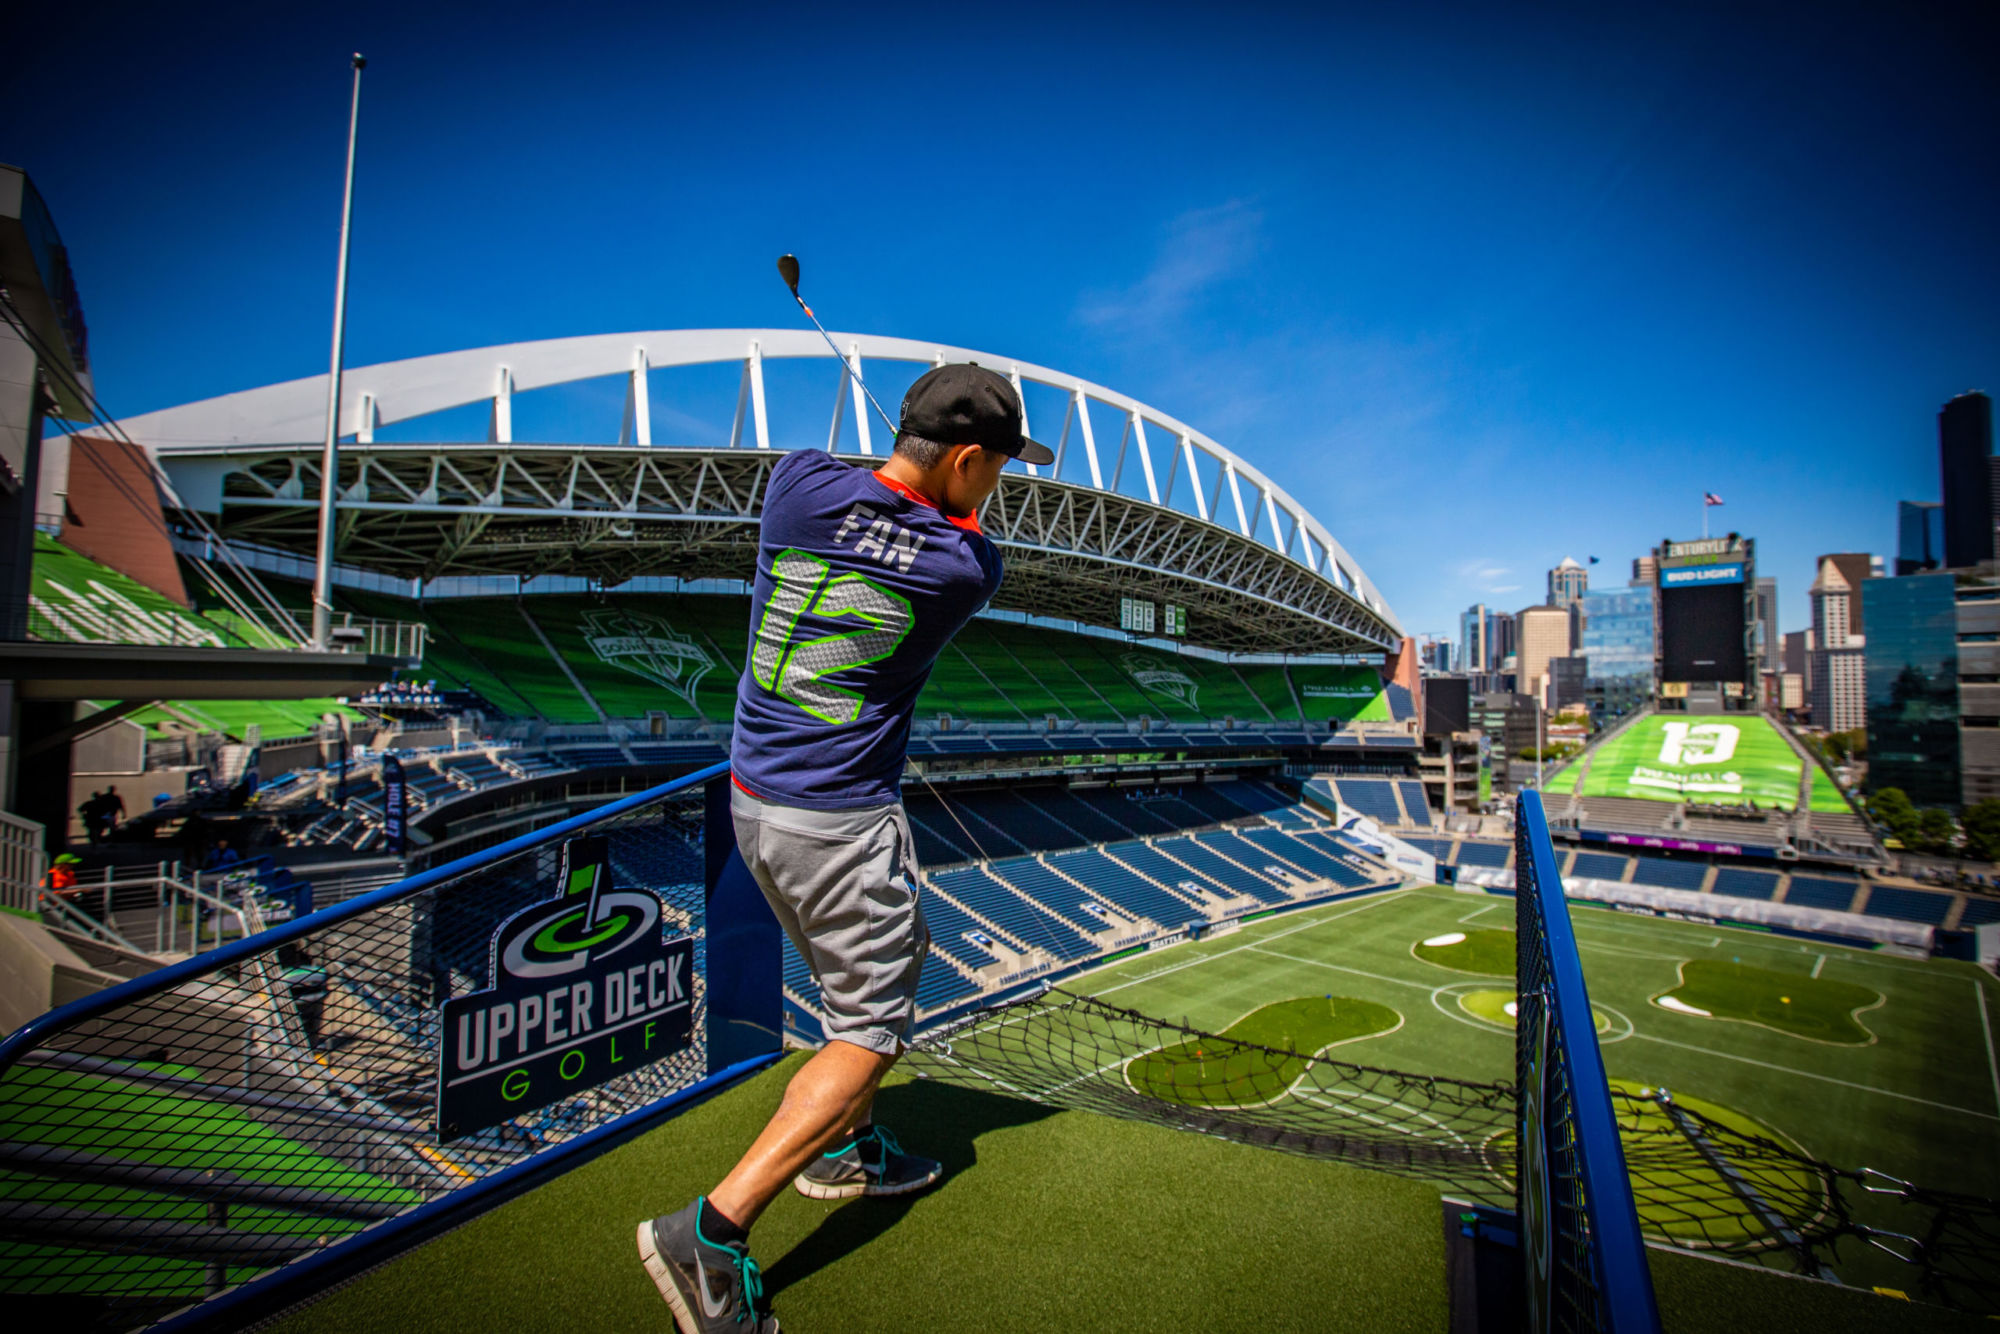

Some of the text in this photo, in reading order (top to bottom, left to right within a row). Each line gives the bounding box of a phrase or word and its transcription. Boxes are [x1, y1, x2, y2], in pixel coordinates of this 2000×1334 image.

[833, 502, 926, 575] FAN
[1667, 537, 1743, 557] ENTURYLIK
[1667, 567, 1738, 582] BUD LIGHT
[752, 547, 916, 725] 12
[387, 782, 401, 816] HOLE
[1148, 932, 1185, 950] SEATTLE
[457, 952, 685, 1071] UPPER DECK
[501, 1021, 657, 1101] GOLF
